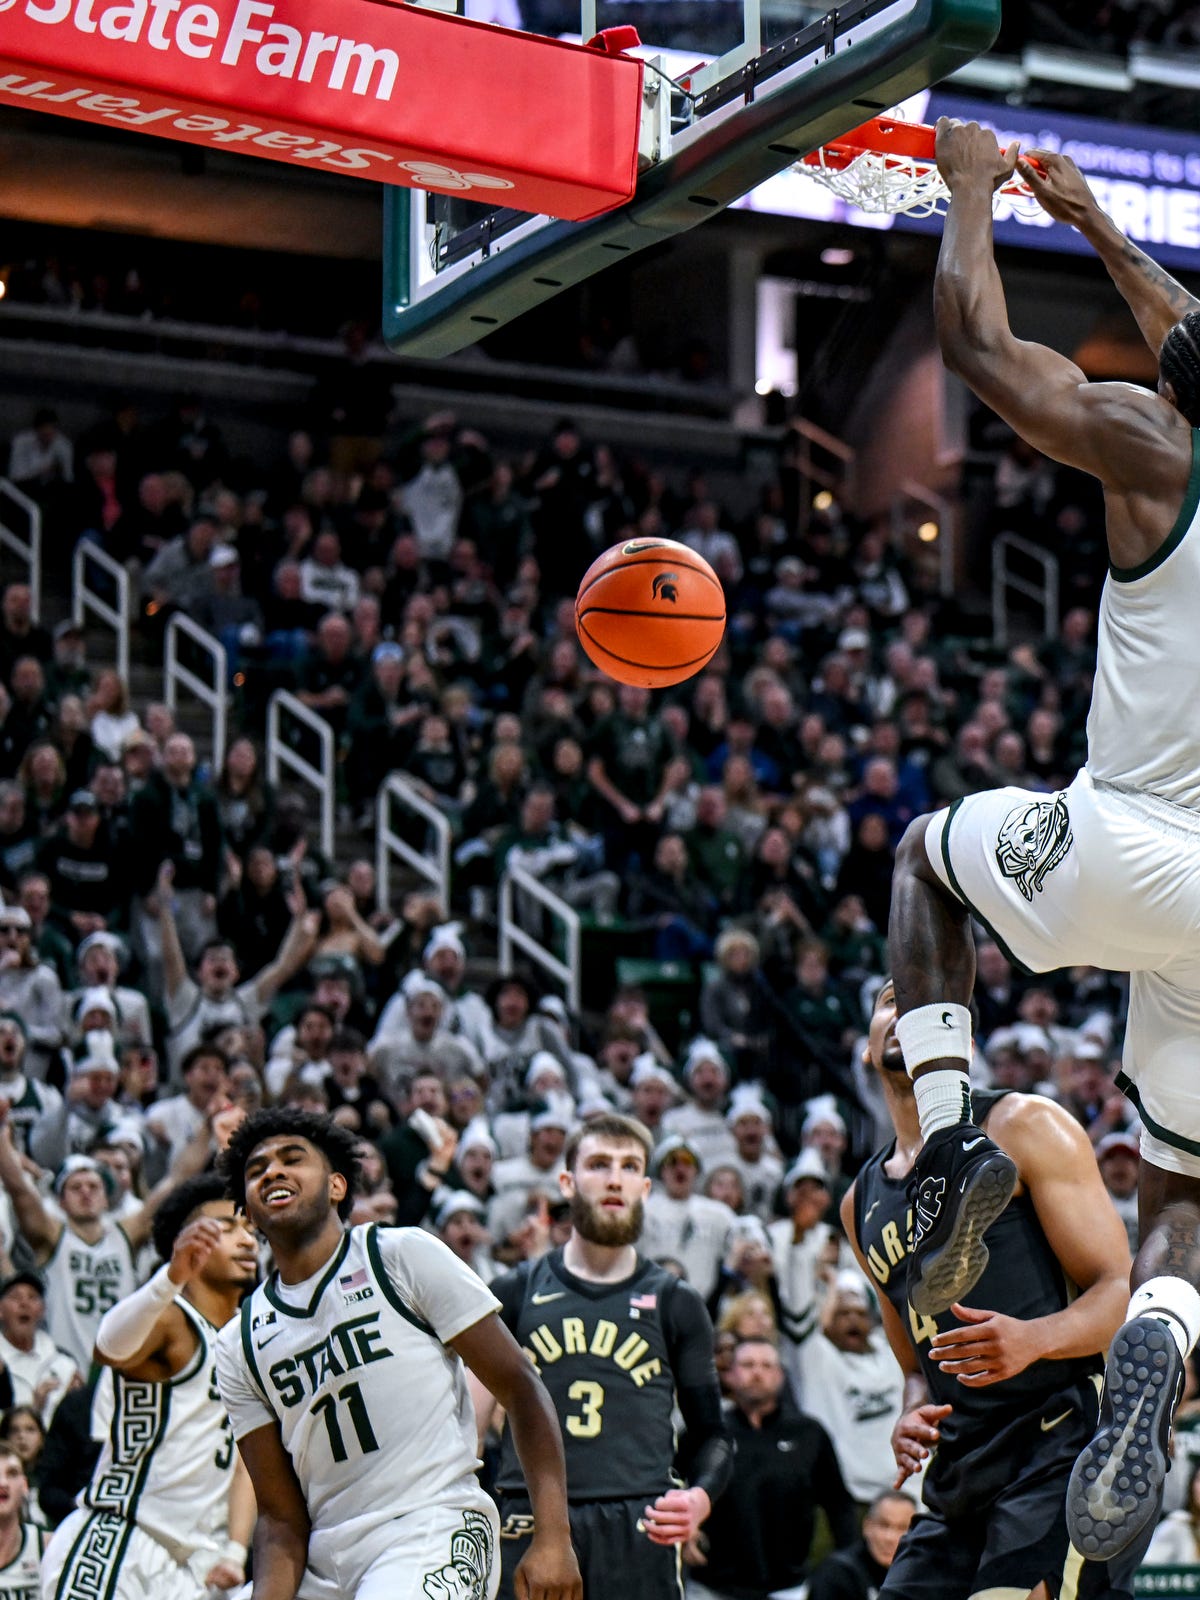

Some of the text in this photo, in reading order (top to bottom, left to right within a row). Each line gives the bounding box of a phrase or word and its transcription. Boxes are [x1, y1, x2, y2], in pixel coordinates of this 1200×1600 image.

[1153, 150, 1186, 183] to
[75, 1279, 120, 1315] 55
[269, 1311, 394, 1408] STATE
[522, 1317, 662, 1388] URDUE
[310, 1382, 380, 1463] 11
[566, 1380, 604, 1438] 3
